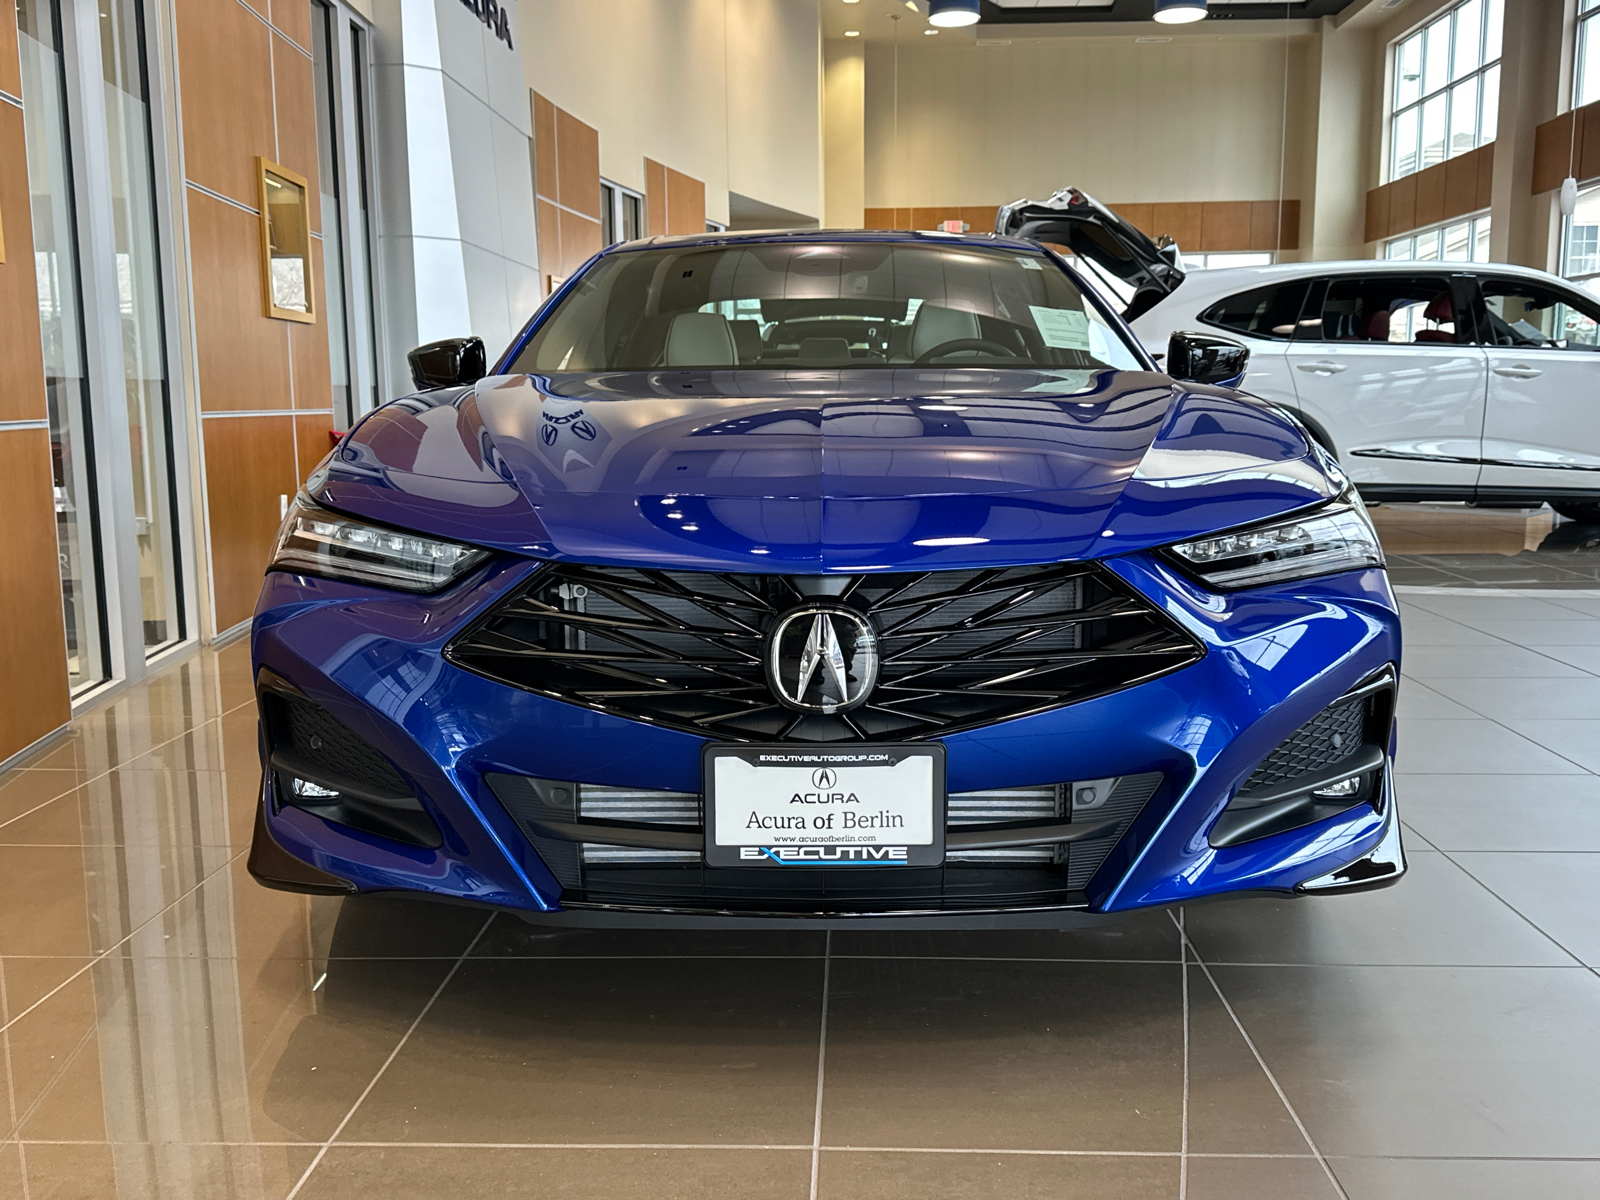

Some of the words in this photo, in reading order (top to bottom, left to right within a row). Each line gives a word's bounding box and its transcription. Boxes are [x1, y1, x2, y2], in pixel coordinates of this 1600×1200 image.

[459, 0, 514, 51] URA
[759, 754, 889, 762] EXECUTIVEAUTOGROUP.COM
[789, 793, 861, 804] ACURA
[745, 810, 807, 829] Acura
[812, 813, 834, 830] of
[842, 810, 905, 829] Berlin
[773, 835, 877, 843] www.acuraofberlin.com
[739, 846, 908, 861] EXECUTIVE
